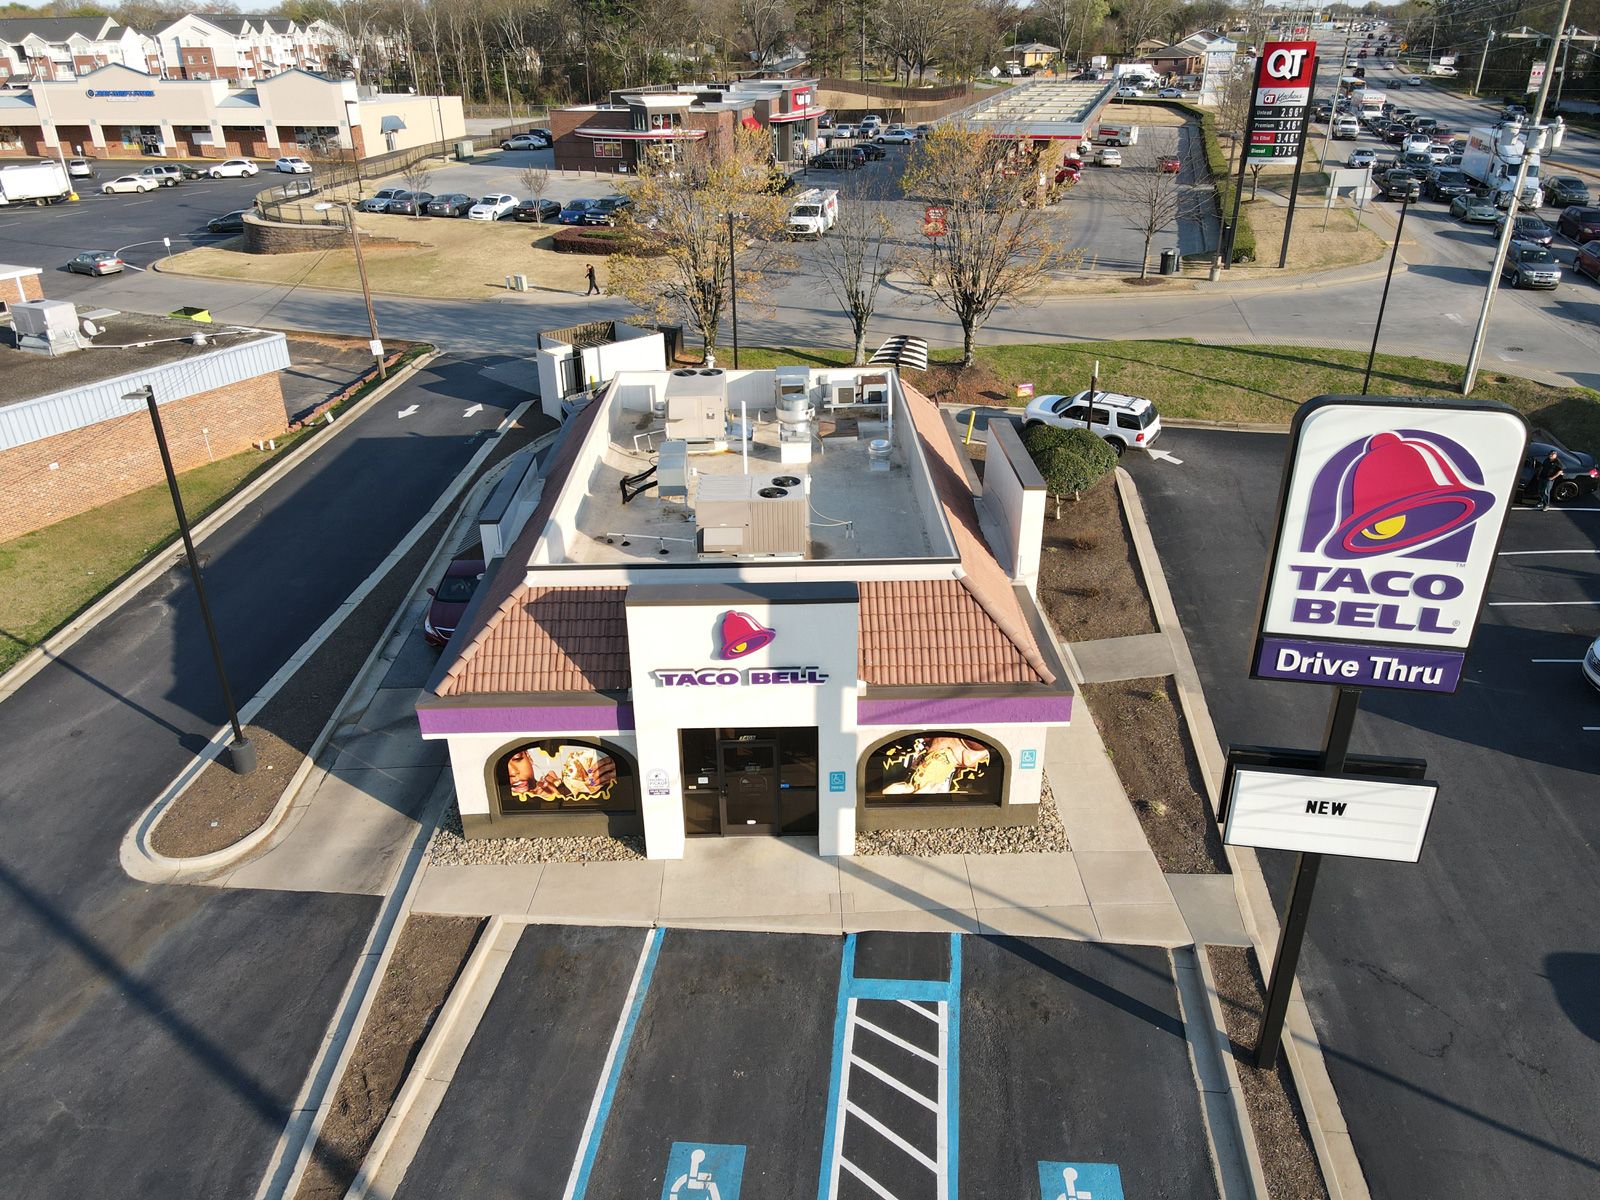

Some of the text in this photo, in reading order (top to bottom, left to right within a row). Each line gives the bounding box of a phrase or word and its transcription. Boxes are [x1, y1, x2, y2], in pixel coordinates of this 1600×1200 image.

[1267, 49, 1307, 80] QT
[1264, 95, 1275, 103] QT
[1289, 565, 1464, 601] TACO
[1291, 598, 1457, 634] BELL
[658, 671, 828, 686] TACO BELL
[1276, 648, 1444, 685] Drive Thru
[1305, 800, 1347, 816] NEW
